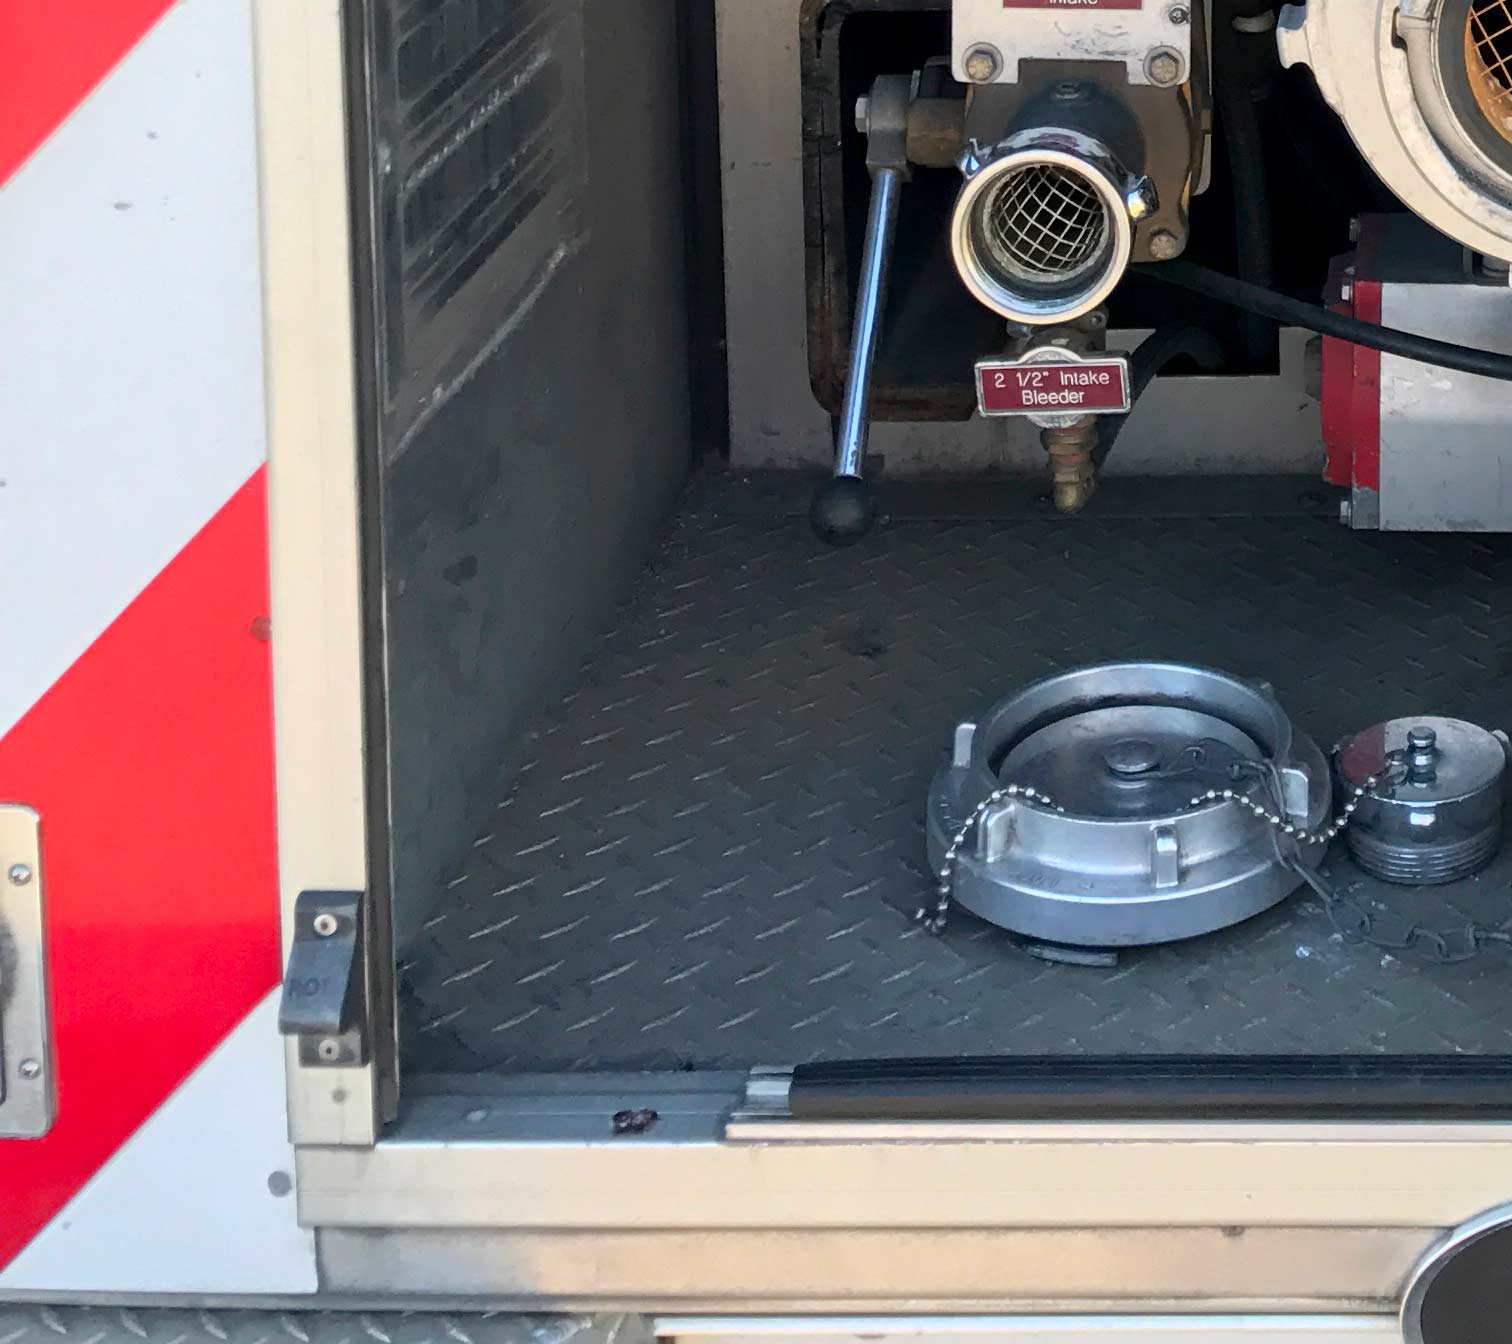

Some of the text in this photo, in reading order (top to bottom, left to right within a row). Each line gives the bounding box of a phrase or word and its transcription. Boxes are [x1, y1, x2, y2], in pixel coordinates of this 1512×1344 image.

[994, 370, 1110, 388] 2 1/2" Intake
[1021, 389, 1085, 405] Bleeder
